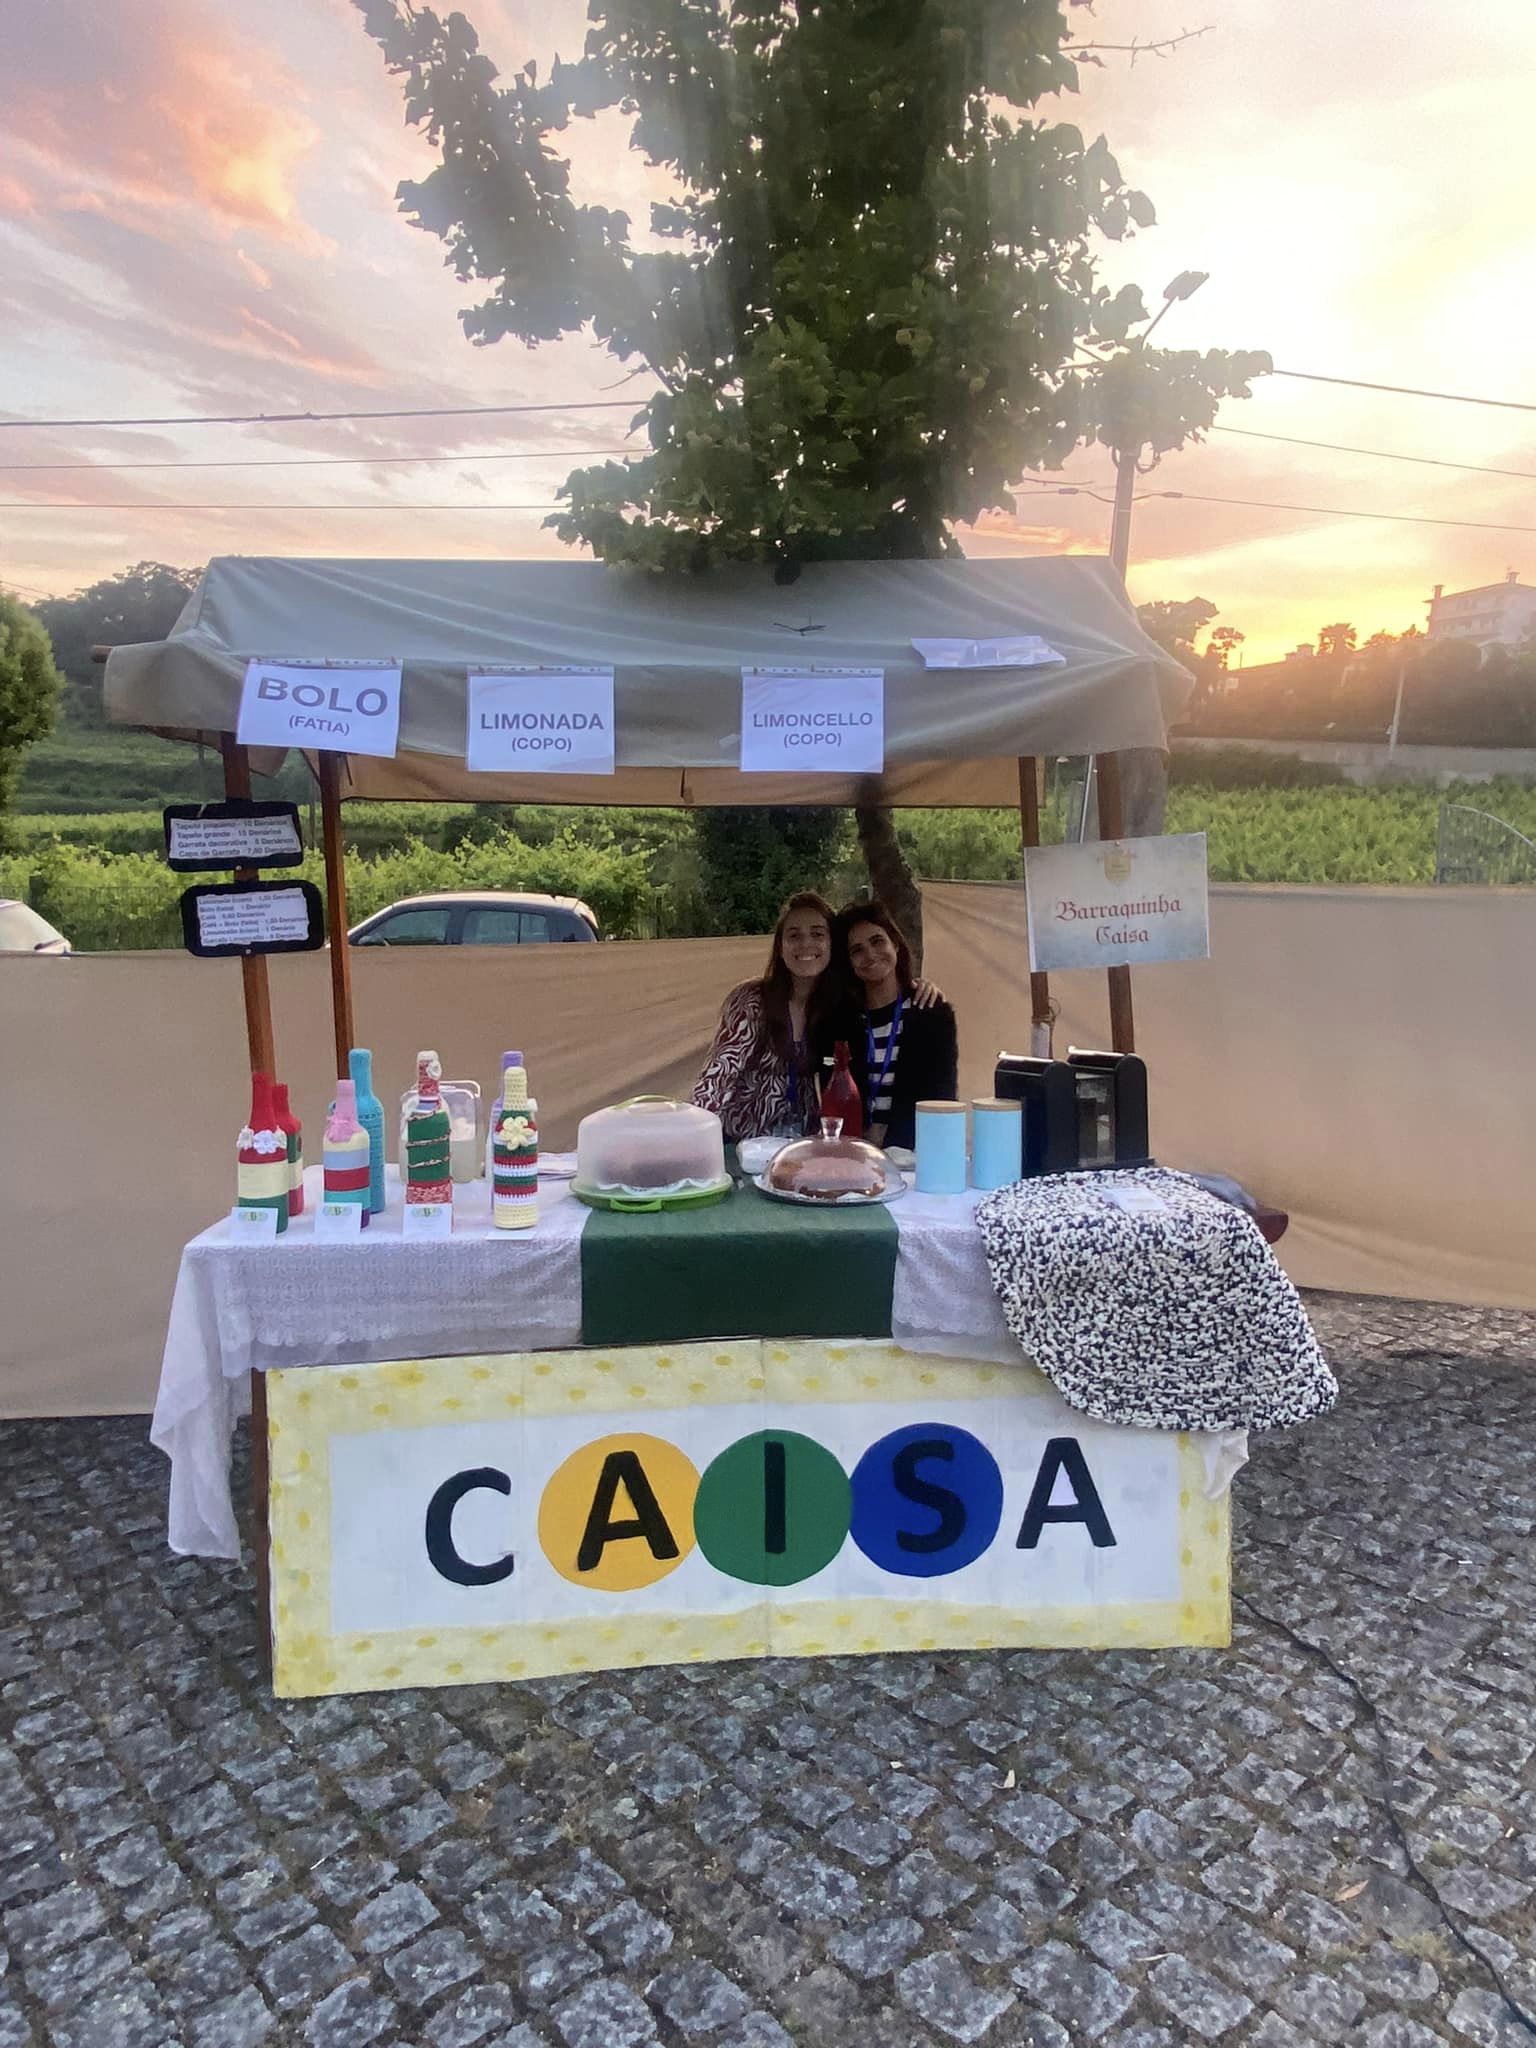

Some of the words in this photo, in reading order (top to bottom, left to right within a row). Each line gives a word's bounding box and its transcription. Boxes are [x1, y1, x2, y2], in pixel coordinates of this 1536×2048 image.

[257, 676, 389, 717] BOLO
[288, 714, 350, 736] (FATIA)
[480, 712, 605, 731] LIMONADA
[752, 712, 873, 729] LIMONCELLO
[511, 736, 572, 753] (COPO)
[783, 732, 842, 748] (COPO)
[1055, 893, 1183, 921] Barraquinha
[1096, 924, 1150, 945] Caisa
[424, 1436, 1118, 1588] CAISA
